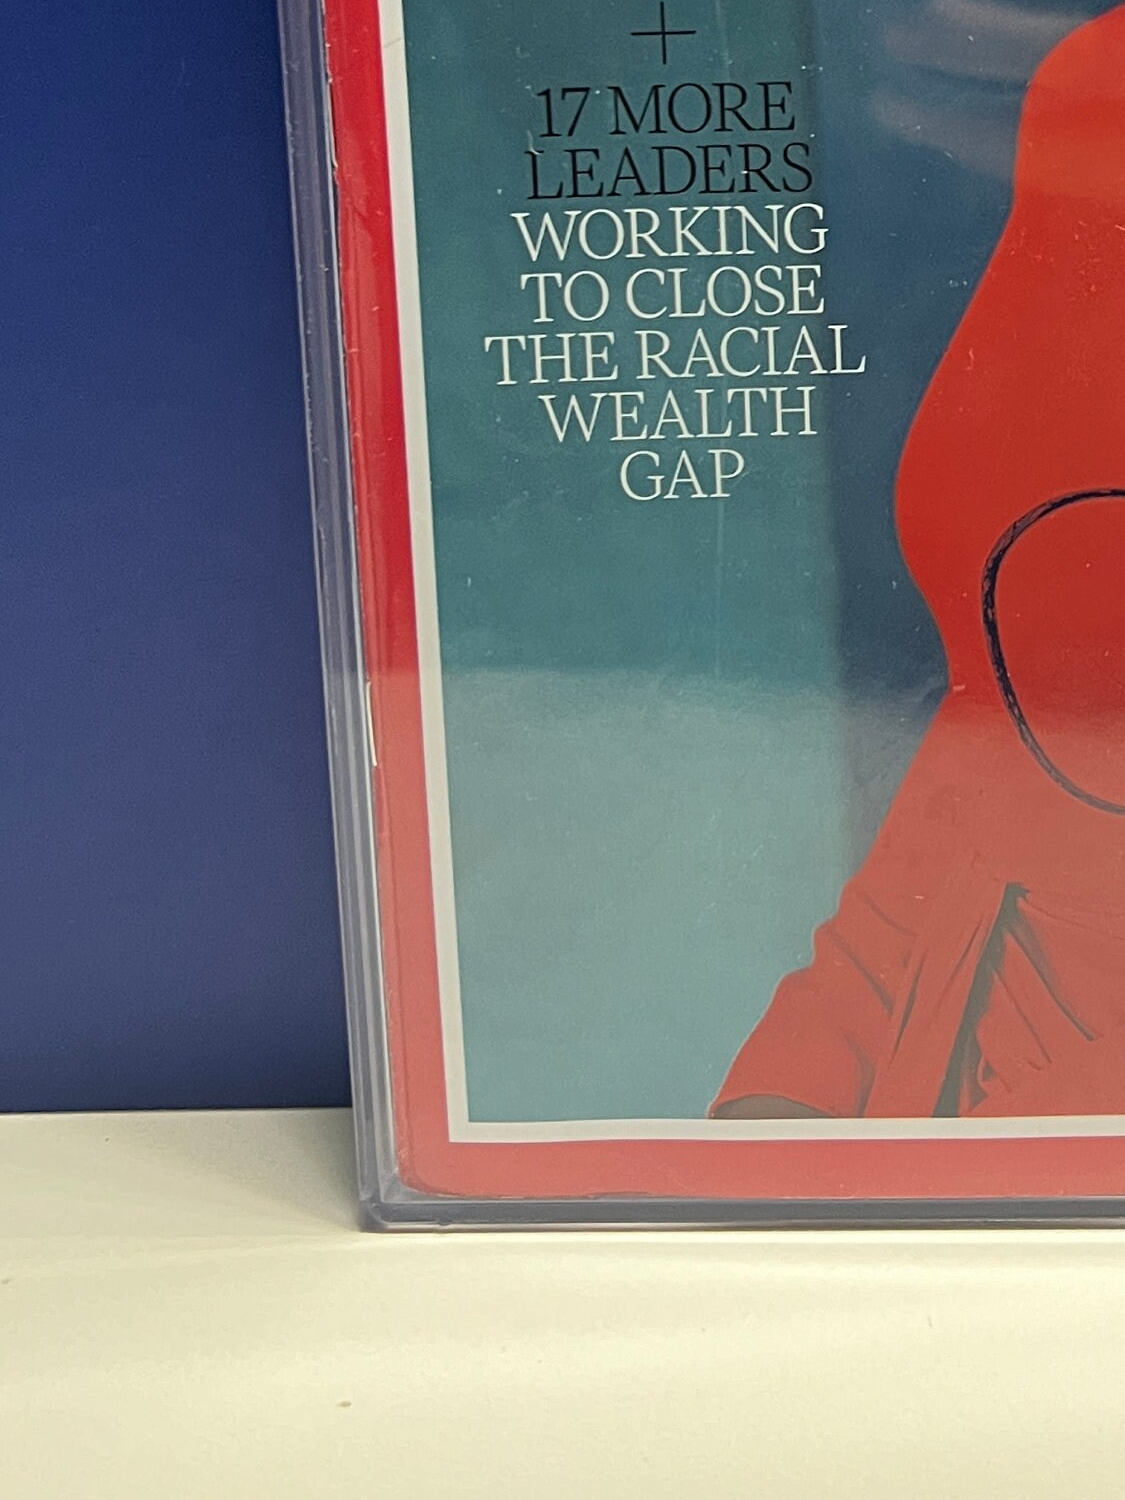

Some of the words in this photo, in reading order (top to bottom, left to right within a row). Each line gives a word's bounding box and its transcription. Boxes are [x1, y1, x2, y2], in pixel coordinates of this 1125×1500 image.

[536, 86, 591, 138] 17
[607, 81, 795, 136] MORE
[524, 141, 814, 200] LEADERS
[510, 202, 829, 261] WORKING
[520, 270, 610, 323] TO
[625, 264, 825, 319] CLOSE
[484, 331, 619, 386] THE
[634, 324, 867, 380] RACIAL
[537, 385, 818, 443] WEALTH
[619, 448, 745, 501] GAP
